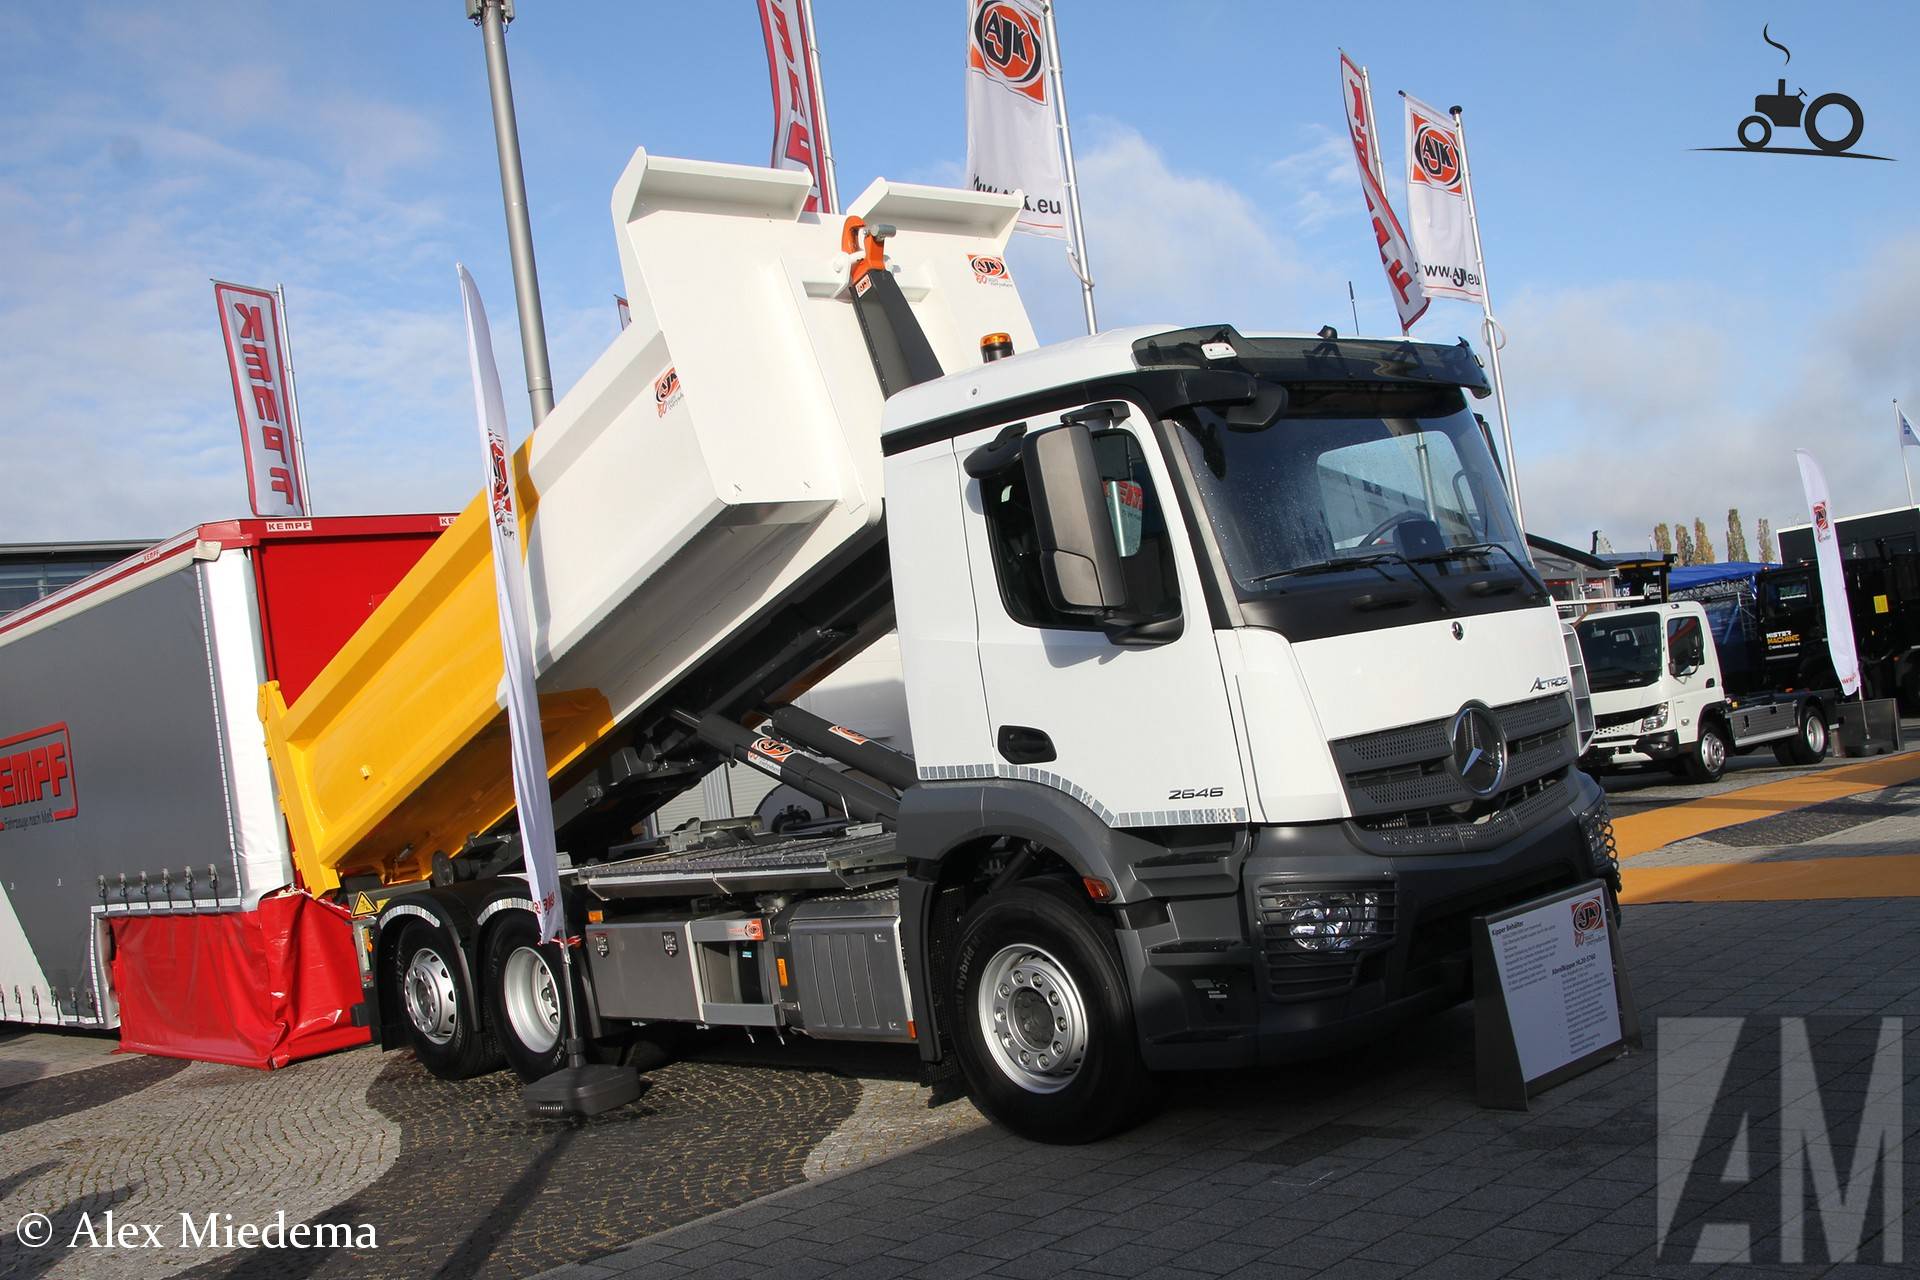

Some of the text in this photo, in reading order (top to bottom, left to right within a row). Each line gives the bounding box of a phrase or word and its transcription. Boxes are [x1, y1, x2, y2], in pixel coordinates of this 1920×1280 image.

[985, 9, 1028, 67] AJK
[1423, 133, 1456, 176] AJK
[268, 522, 311, 530] KEMPF
[0, 742, 68, 808] EMPF
[1168, 787, 1224, 800] 2646
